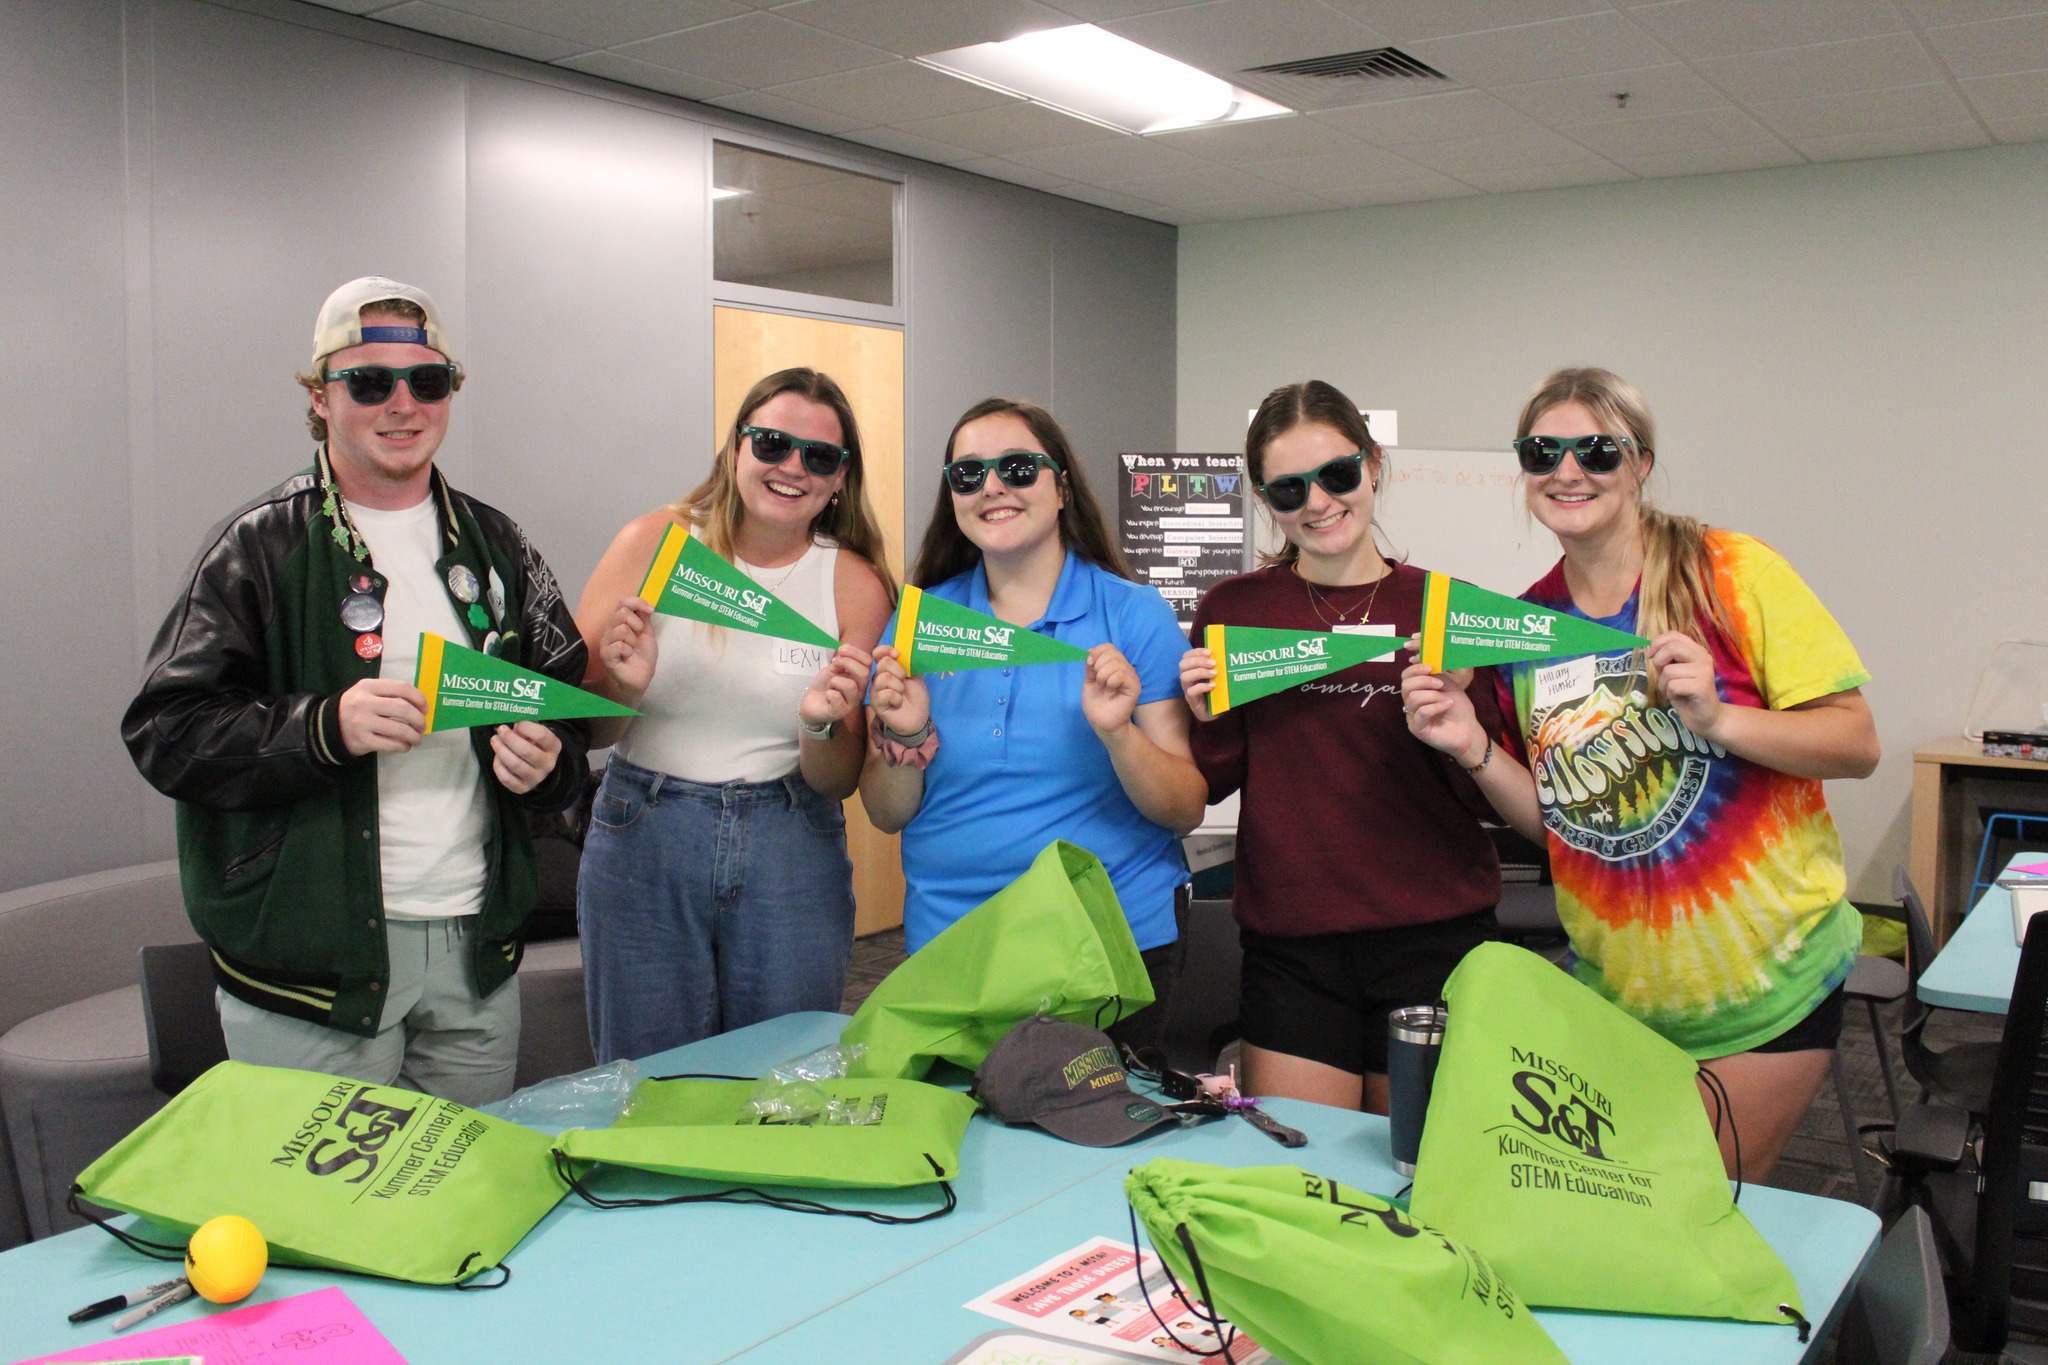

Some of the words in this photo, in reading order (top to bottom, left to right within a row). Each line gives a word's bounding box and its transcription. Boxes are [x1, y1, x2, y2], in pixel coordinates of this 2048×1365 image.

[1121, 455, 1165, 467] When
[1172, 457, 1199, 470] you
[1206, 456, 1244, 467] teach
[1166, 548, 1199, 556] Gateway
[671, 584, 694, 600] Kummer
[693, 593, 712, 607] Center
[710, 601, 719, 611] for
[718, 604, 735, 618] STEM
[732, 609, 759, 628] Education
[675, 563, 740, 601] MISSOURI
[738, 589, 772, 616] S&T
[918, 620, 981, 640] MISSOURI
[982, 626, 1015, 647] S&T
[1449, 612, 1520, 631] MISSOURI
[1521, 613, 1556, 636] S&T
[1451, 634, 1475, 646] Kummer
[1475, 636, 1495, 648] Center
[1495, 637, 1504, 648] for
[1504, 638, 1521, 649] STEM
[1521, 639, 1551, 652] Education
[917, 642, 940, 653] Kummer
[939, 644, 957, 655] Center
[957, 646, 966, 656] for
[966, 647, 981, 658] STEM
[981, 649, 1008, 661] Education
[1229, 646, 1295, 666] MISSOURI
[1297, 637, 1329, 659] S&T
[442, 673, 510, 694] MISSOURI
[511, 678, 547, 700] S&T
[1233, 671, 1257, 682] Kummer
[1257, 668, 1275, 679] Center
[1275, 666, 1284, 676] for
[1284, 664, 1299, 675] STEM
[1299, 662, 1328, 673] Education
[442, 696, 466, 707] Kummer
[465, 698, 484, 709] Center
[484, 700, 493, 710] for
[493, 701, 510, 712] STEM
[509, 703, 539, 716] Education
[1547, 811, 1601, 849] FIRST
[1621, 761, 1704, 855] GROOVIEST
[1510, 1046, 1613, 1117] MISSOURI
[270, 1081, 357, 1169] MISSOURI
[305, 1086, 417, 1184] S&T
[1511, 1071, 1616, 1162] S&T
[371, 1152, 426, 1199] Kummer
[417, 1115, 452, 1155] Center
[408, 1168, 449, 1197] STEM
[434, 1119, 490, 1172] Education
[1499, 1133, 1566, 1169] Kummer
[1568, 1159, 1626, 1184] Center
[1627, 1172, 1653, 1189] for
[1511, 1163, 1561, 1190] STEM
[1564, 1172, 1653, 1208] Education
[1010, 1277, 1060, 1304] WELCOME
[1057, 1270, 1074, 1279] TO
[1026, 1293, 1062, 1313] SAVE
[1056, 1274, 1098, 1295] THOSE
